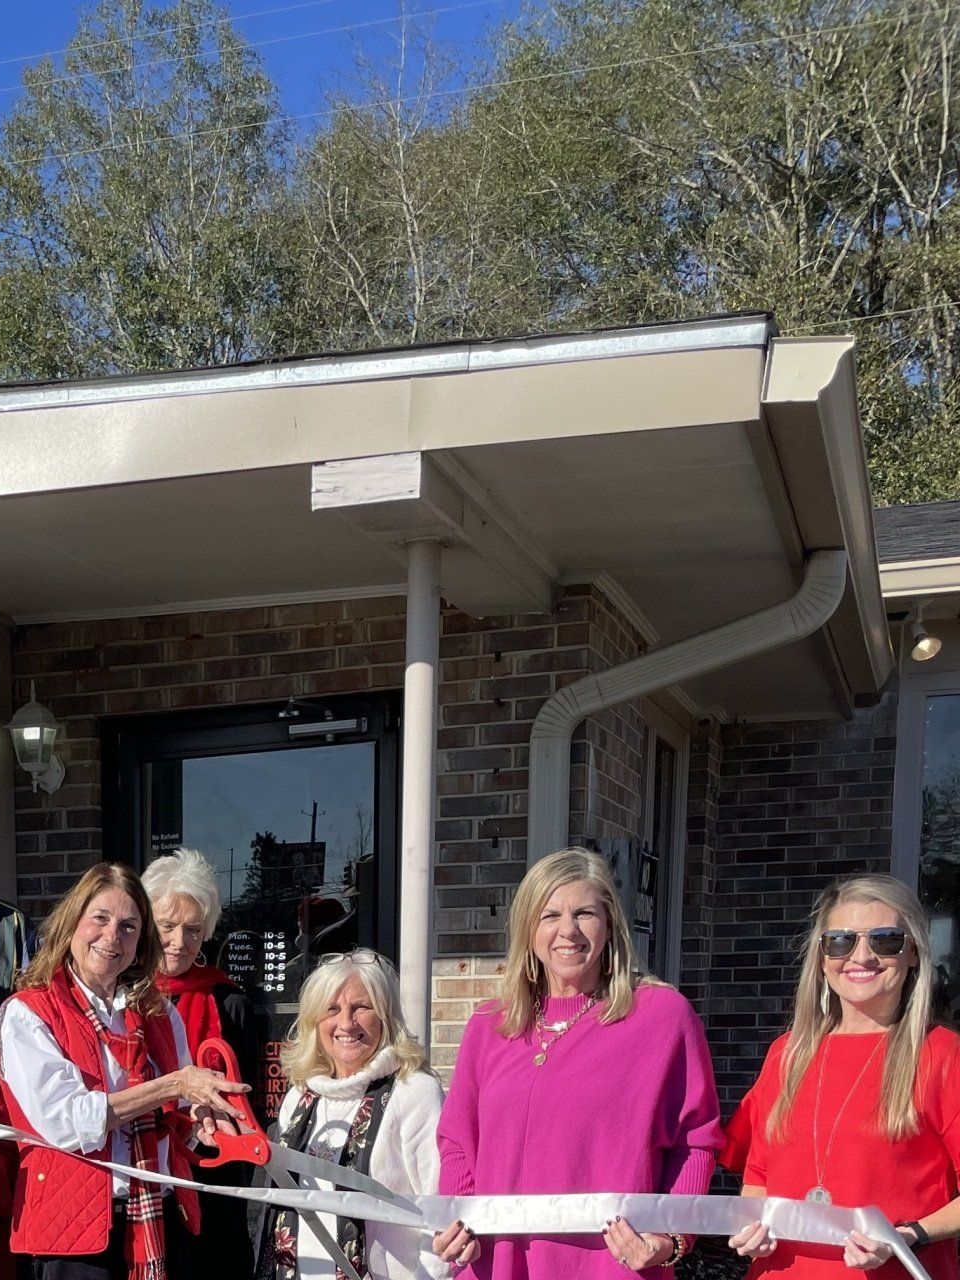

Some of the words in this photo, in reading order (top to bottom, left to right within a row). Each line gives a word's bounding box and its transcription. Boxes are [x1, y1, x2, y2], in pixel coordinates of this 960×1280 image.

[228, 932, 250, 940] Mon.
[264, 931, 285, 939] 10-5
[264, 941, 285, 950] 10-5
[228, 953, 251, 961] Wed.
[265, 952, 286, 960] 10-5
[228, 963, 257, 971] Thurs.
[264, 962, 286, 971] 10-5
[264, 973, 286, 981] 10-5
